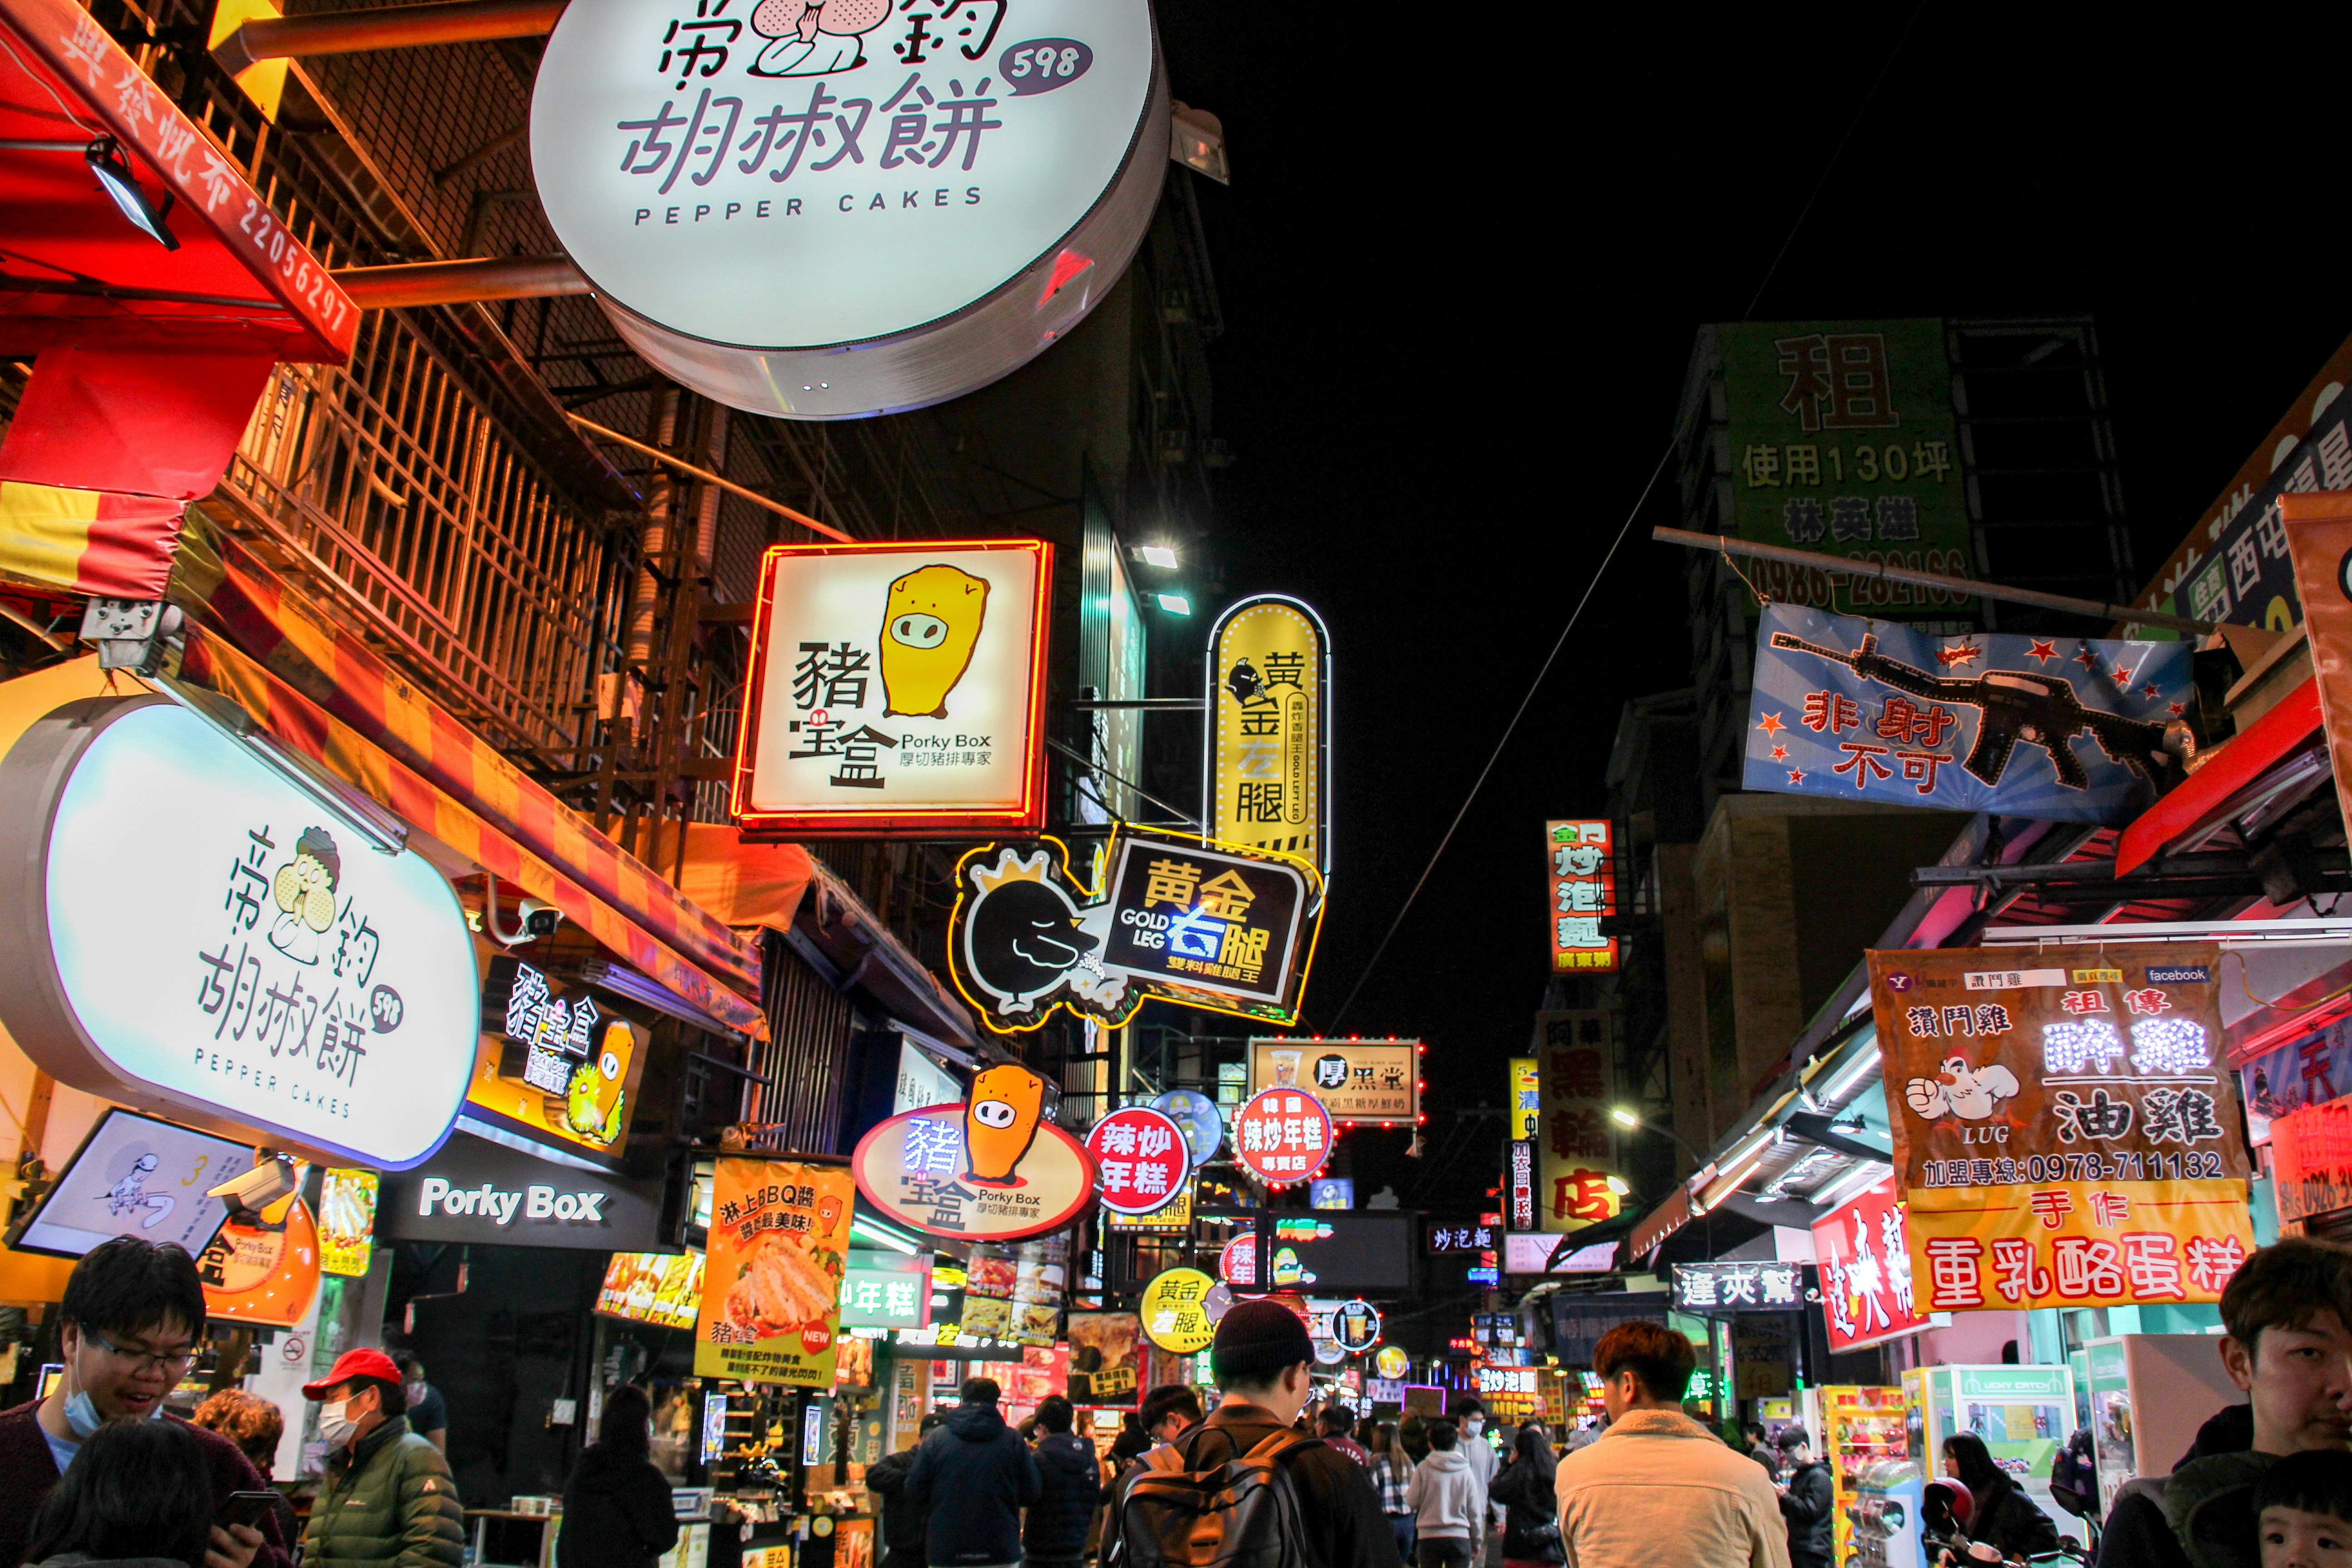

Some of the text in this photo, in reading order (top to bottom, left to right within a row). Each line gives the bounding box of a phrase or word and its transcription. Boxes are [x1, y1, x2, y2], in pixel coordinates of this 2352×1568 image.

[1010, 46, 1079, 79] 598
[617, 71, 1002, 195] 胡椒餅
[634, 186, 982, 227] PEPPER CAKES
[240, 198, 347, 333] 22056297
[1774, 333, 1900, 431] 租
[1742, 441, 1951, 488] 使用130坪
[1784, 495, 1920, 543] 林英雄
[791, 642, 871, 710] 豬
[1801, 689, 1953, 749] 非射
[902, 734, 992, 751] Porky Box
[1237, 652, 1305, 823] 黃金左腿
[899, 751, 992, 766] 厚切豬排專家
[1833, 742, 1953, 794] 不可
[1144, 859, 1256, 923] 黃金
[1121, 908, 1170, 931] GOLD
[331, 896, 378, 988] 鈞
[1132, 929, 1166, 950] LEG
[1169, 904, 1270, 971] 右腿
[1166, 955, 1259, 984] 雙料雞腿王
[1558, 951, 1611, 968] 廣東粥
[2150, 967, 2206, 982] facebook
[198, 942, 367, 1087] 胡椒餅
[372, 992, 401, 1024] 598
[2061, 988, 2171, 1015] 祖傳
[2042, 1018, 2212, 1076] 醉雞
[550, 1053, 572, 1077] Box
[1318, 1058, 1405, 1090] 厚黑堂
[195, 1048, 350, 1118] PEPPER CAKES
[1262, 1096, 1302, 1115] 韓國
[2053, 1088, 2224, 1146] 油雞
[905, 1117, 961, 1175] 豬
[1101, 1122, 1172, 1157] 辣炒
[1243, 1117, 1323, 1152] 辣炒年糕
[1963, 1127, 2009, 1144] LUG
[181, 1155, 208, 1186] 3
[1101, 1160, 1169, 1195] 年糕
[1261, 1155, 1306, 1171] 專賣店
[1924, 1152, 2225, 1187] 加盟專線:0978-711132
[418, 1177, 605, 1225] Porky Box
[719, 1185, 814, 1227] 淋上BBQ醬
[976, 1203, 1041, 1219] 厚切豬排專家
[978, 1189, 1041, 1206] Porky Box
[2031, 1191, 2130, 1230] 手作
[235, 1238, 273, 1255] Porky Box
[1435, 1227, 1492, 1251] 炒泡麵
[1681, 1269, 1795, 1306] 逢夾幫
[1925, 1231, 2245, 1309] 重乳酪蛋糕
[1158, 1280, 1199, 1300] 黃金
[803, 1330, 830, 1343] NEW
[1152, 1309, 1199, 1333] 左腿
